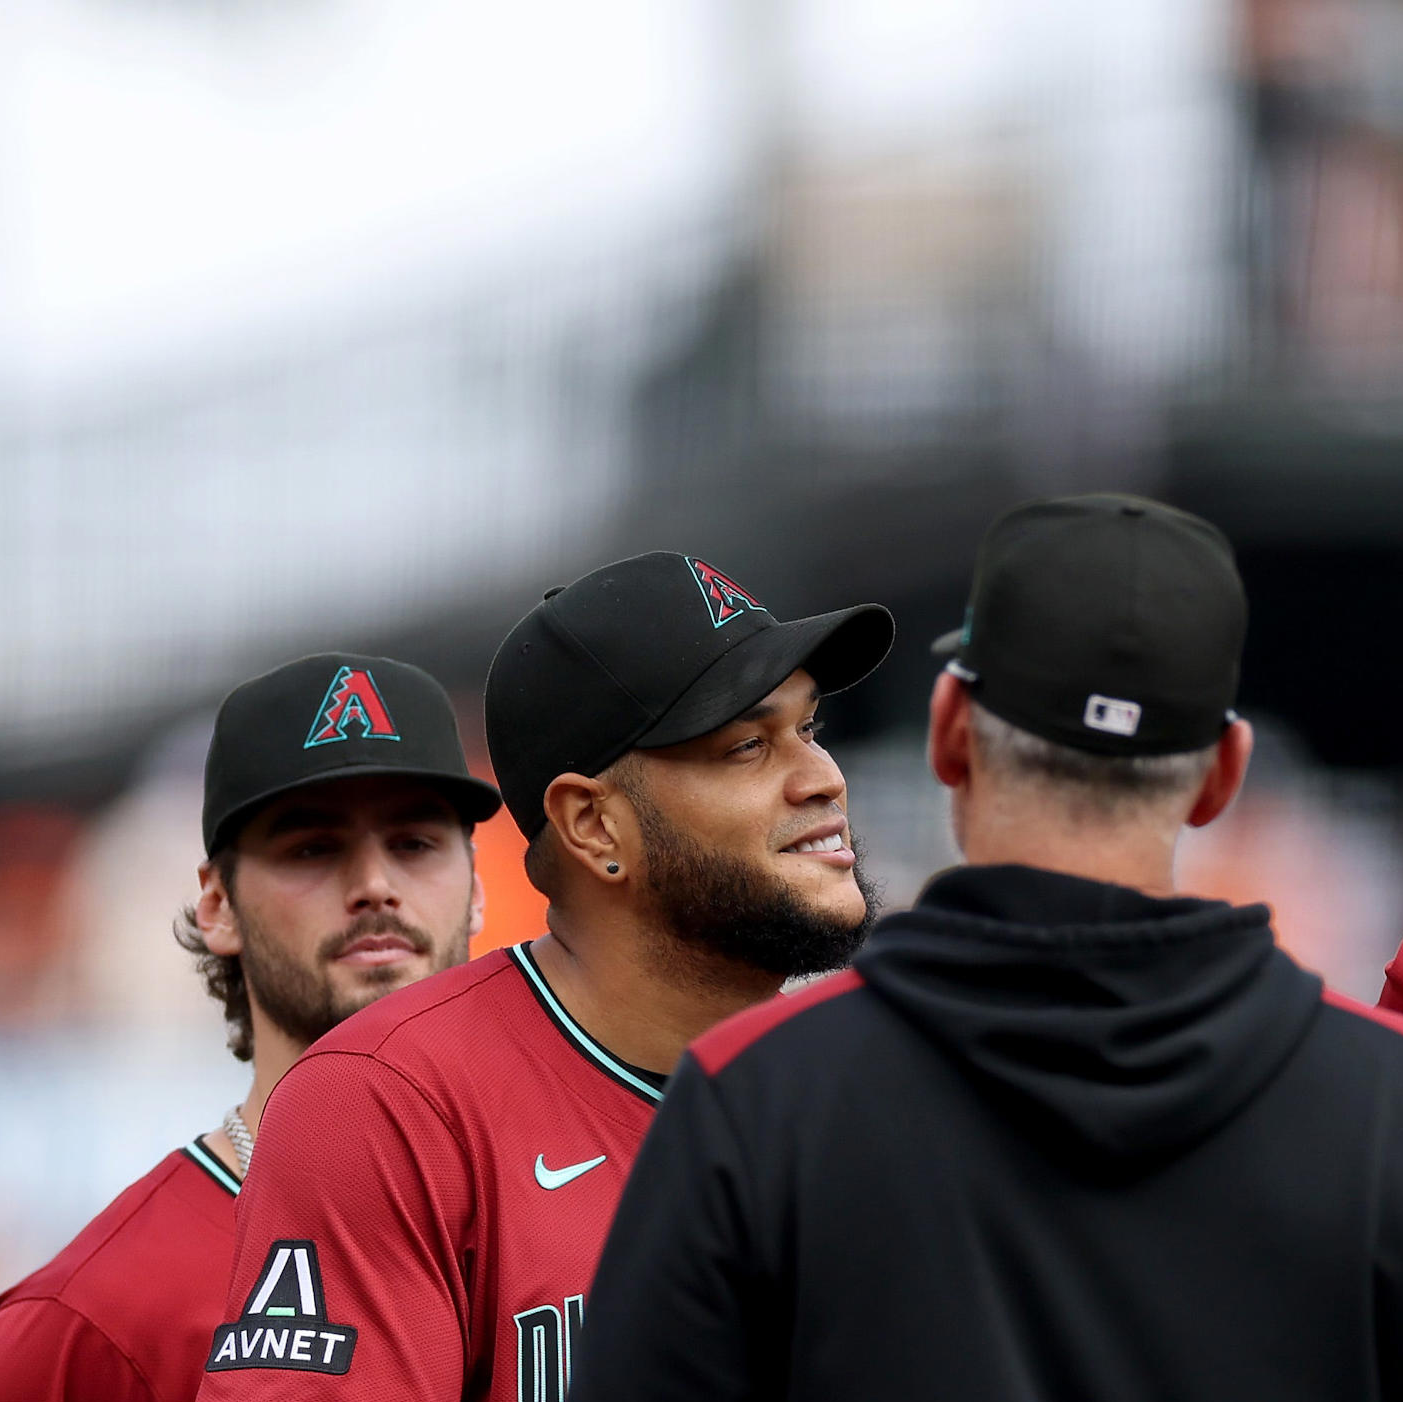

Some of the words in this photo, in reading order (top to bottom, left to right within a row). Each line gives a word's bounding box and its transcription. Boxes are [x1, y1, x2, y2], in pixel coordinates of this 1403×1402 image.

[684, 556, 768, 628] A
[304, 666, 400, 748] A
[214, 1328, 346, 1365] AVNET
